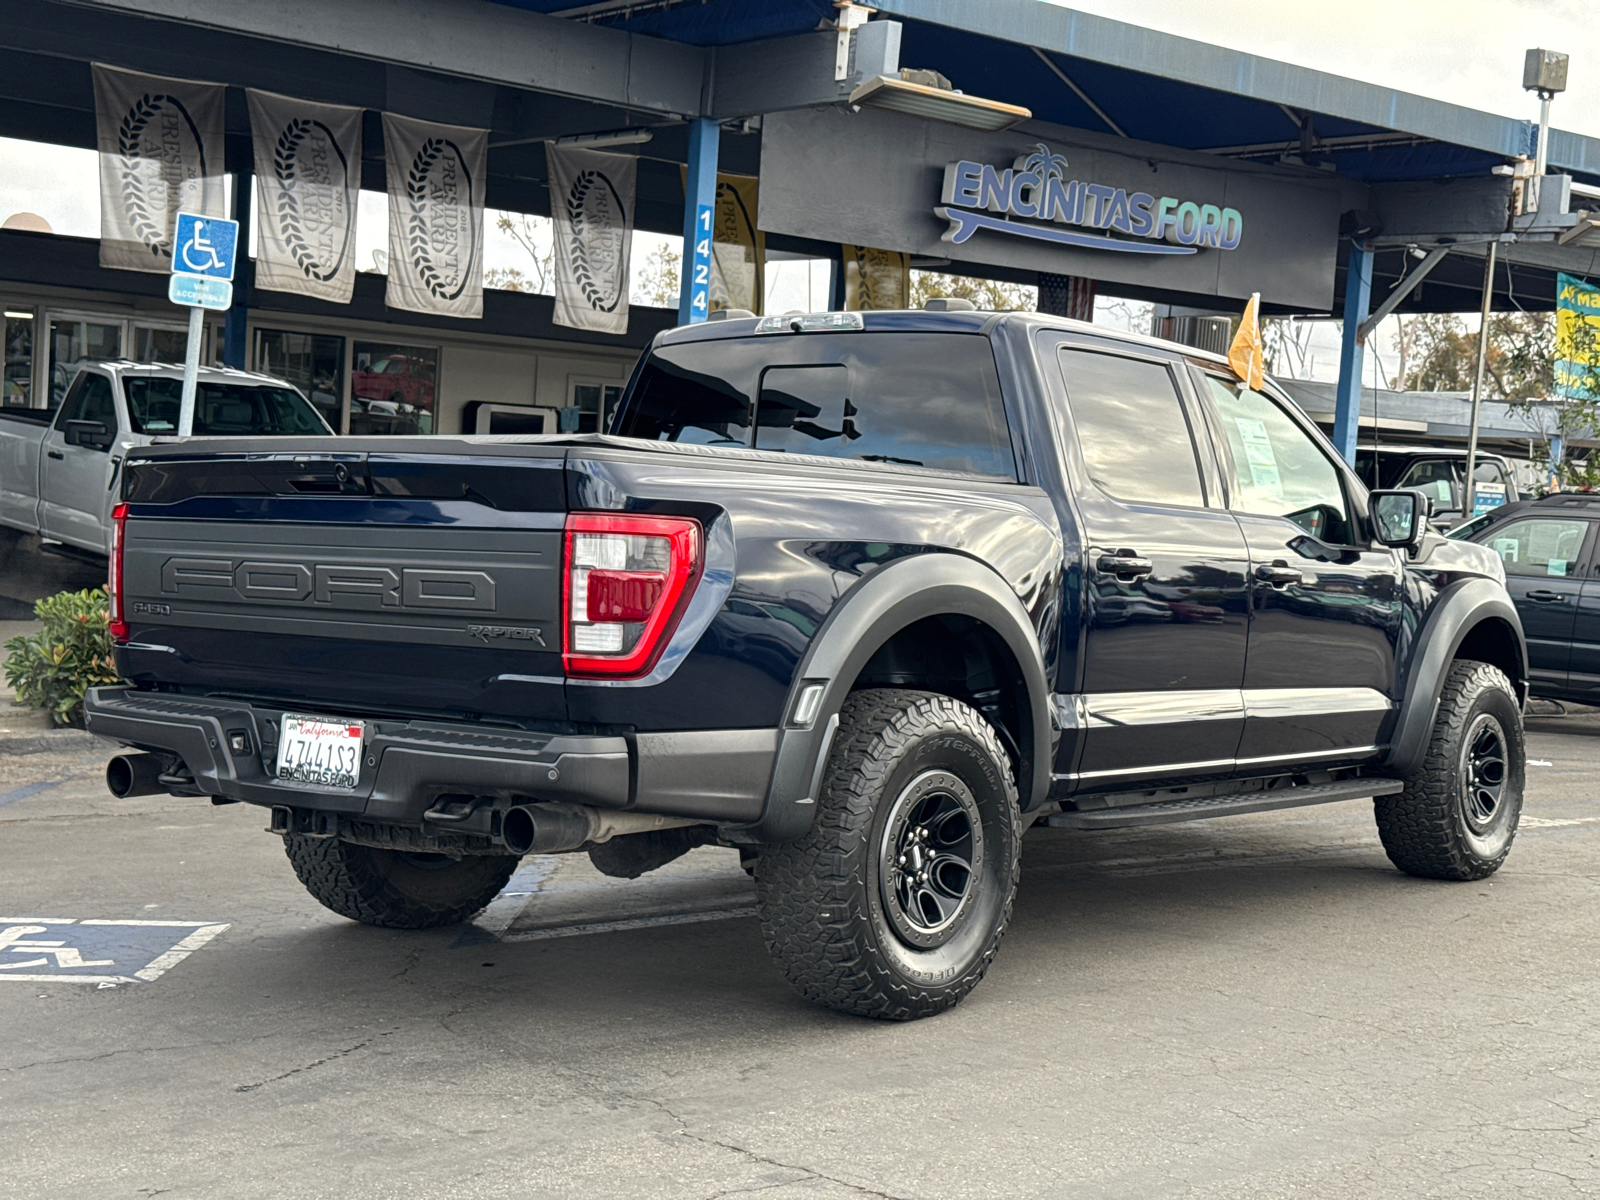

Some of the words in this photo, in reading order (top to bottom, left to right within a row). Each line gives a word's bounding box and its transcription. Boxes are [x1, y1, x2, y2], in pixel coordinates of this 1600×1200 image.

[145, 137, 167, 211] AWARD
[161, 112, 184, 243] PRESIDEN
[187, 167, 197, 191] 2016
[299, 158, 319, 232] AWARD
[310, 134, 333, 269] PRESIDENT'S
[334, 189, 343, 214] 2017
[952, 156, 1156, 237] ENCINITAS
[1157, 196, 1243, 250] FORD
[429, 180, 446, 253] AWARD
[442, 154, 459, 287] PRESIDENT'S
[585, 208, 603, 271] AWARD
[594, 186, 615, 301] PRESIDENT'S
[193, 283, 210, 292] VAN
[693, 210, 711, 311] 1424
[133, 602, 171, 616] F-150
[161, 557, 497, 612] FORD
[466, 624, 546, 647] RAPTOR
[288, 722, 298, 731] JAN
[300, 721, 349, 740] California
[280, 765, 330, 783] ENCINITAS
[331, 773, 354, 787] FORD
[285, 739, 356, 774] 47441S3
